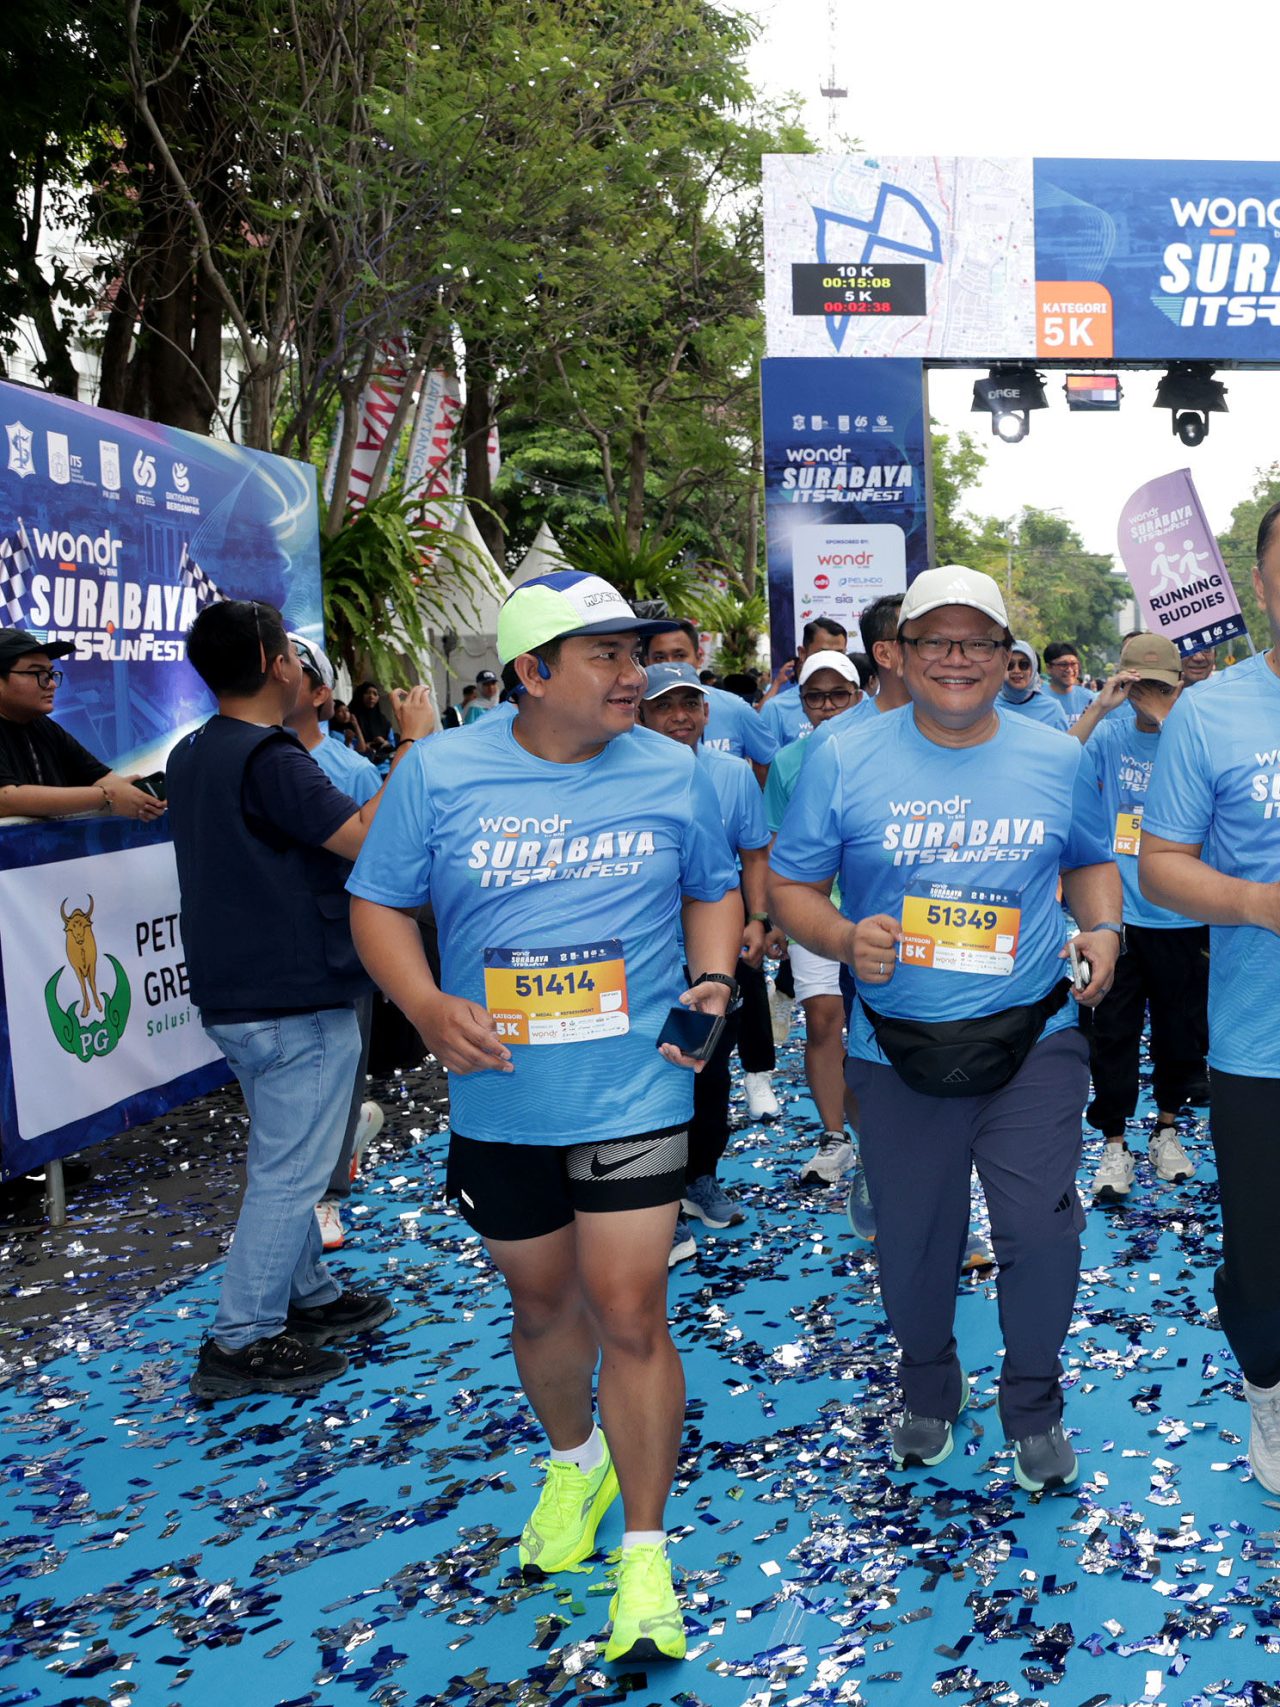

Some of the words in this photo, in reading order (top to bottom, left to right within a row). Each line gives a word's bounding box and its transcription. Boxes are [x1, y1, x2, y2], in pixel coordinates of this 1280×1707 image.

[823, 278, 891, 288] 00:15:08
[837, 267, 856, 277] 10
[861, 267, 874, 277] K
[824, 302, 891, 312] 00:02:38
[845, 291, 854, 301] 5
[859, 291, 872, 301] K
[1043, 303, 1107, 314] KATEGORI
[1044, 317, 1094, 346] 5K
[70, 455, 82, 468] ITS
[786, 445, 851, 462] wondr
[782, 465, 912, 489] SURABAYA
[136, 494, 146, 505] ITS
[166, 502, 200, 515] BERDAMPAK
[1128, 506, 1159, 525] wondr
[1130, 505, 1193, 539] SURABAYA
[32, 528, 122, 565] wondr
[817, 551, 873, 565] wondr
[30, 574, 198, 632] SURABAYA
[1150, 574, 1222, 611] RUNNING
[1159, 592, 1225, 626] BUDDIES
[889, 795, 972, 817] wondr
[478, 813, 573, 834] wondr
[882, 818, 1045, 850] SURABAYA
[468, 831, 655, 870] SURABAYA
[927, 904, 997, 930] 51349
[136, 913, 179, 956] PET
[511, 955, 549, 964] SURABAYA
[905, 945, 926, 959] 5K
[144, 963, 190, 1006] GRE
[516, 970, 595, 997] 51414
[147, 1006, 190, 1037] Solusi
[496, 1022, 519, 1036] 5K
[80, 1029, 109, 1057] PG
